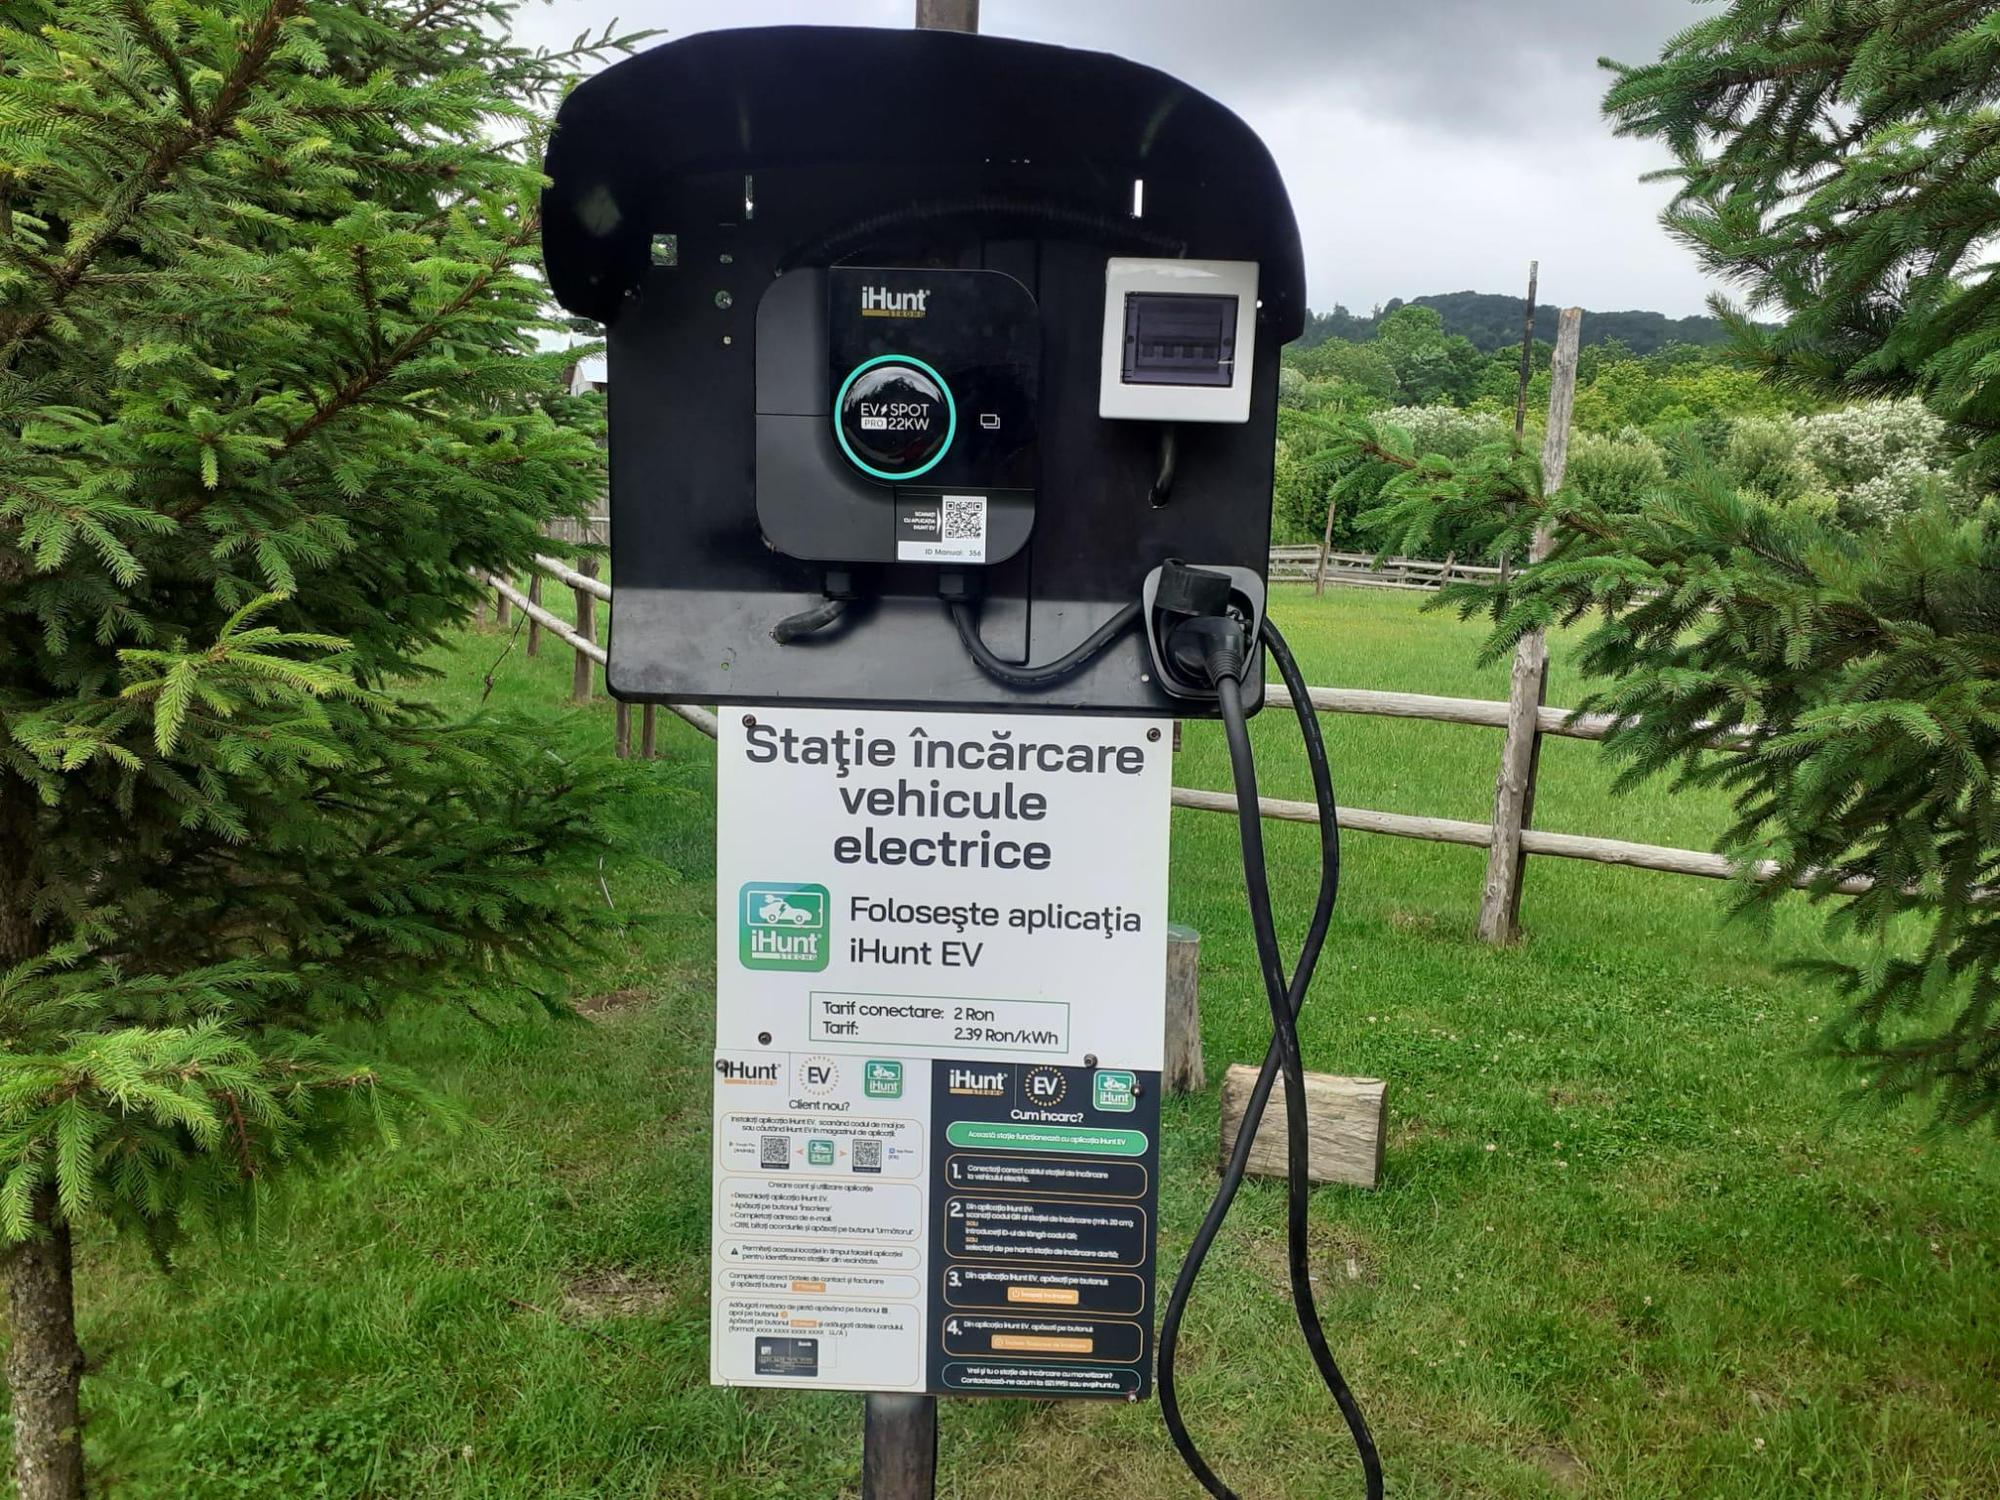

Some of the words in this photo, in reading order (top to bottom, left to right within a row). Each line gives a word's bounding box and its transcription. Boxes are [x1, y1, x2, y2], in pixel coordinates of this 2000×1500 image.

[862, 286, 926, 311] iHunt
[861, 403, 880, 416] EV
[890, 403, 930, 417] SPOT
[864, 419, 884, 428] PRO
[888, 418, 930, 431] 22KW
[908, 726, 1144, 774] încărcare
[839, 778, 1047, 821] vehicule
[834, 826, 1051, 870] electrice
[751, 929, 817, 954] iHunt
[850, 938, 931, 965] iHunt
[942, 942, 984, 968] EV
[823, 1001, 856, 1016] Tarif
[859, 1002, 945, 1020] conectare:
[954, 1007, 963, 1020] 2
[966, 1008, 995, 1022] Ron
[823, 1021, 859, 1036] Tarif:
[954, 1027, 982, 1041] 2.39
[985, 1028, 1058, 1045] Ron/kWh
[808, 1066, 831, 1084] EV
[950, 1069, 1004, 1090] iHunt
[1034, 1076, 1059, 1096] EV
[788, 1099, 820, 1111] Client
[822, 1100, 850, 1112] nou?
[1010, 1109, 1039, 1121] Cum
[952, 1163, 962, 1179] 1.
[948, 1271, 962, 1287] 3.
[947, 1320, 963, 1336] 4.
